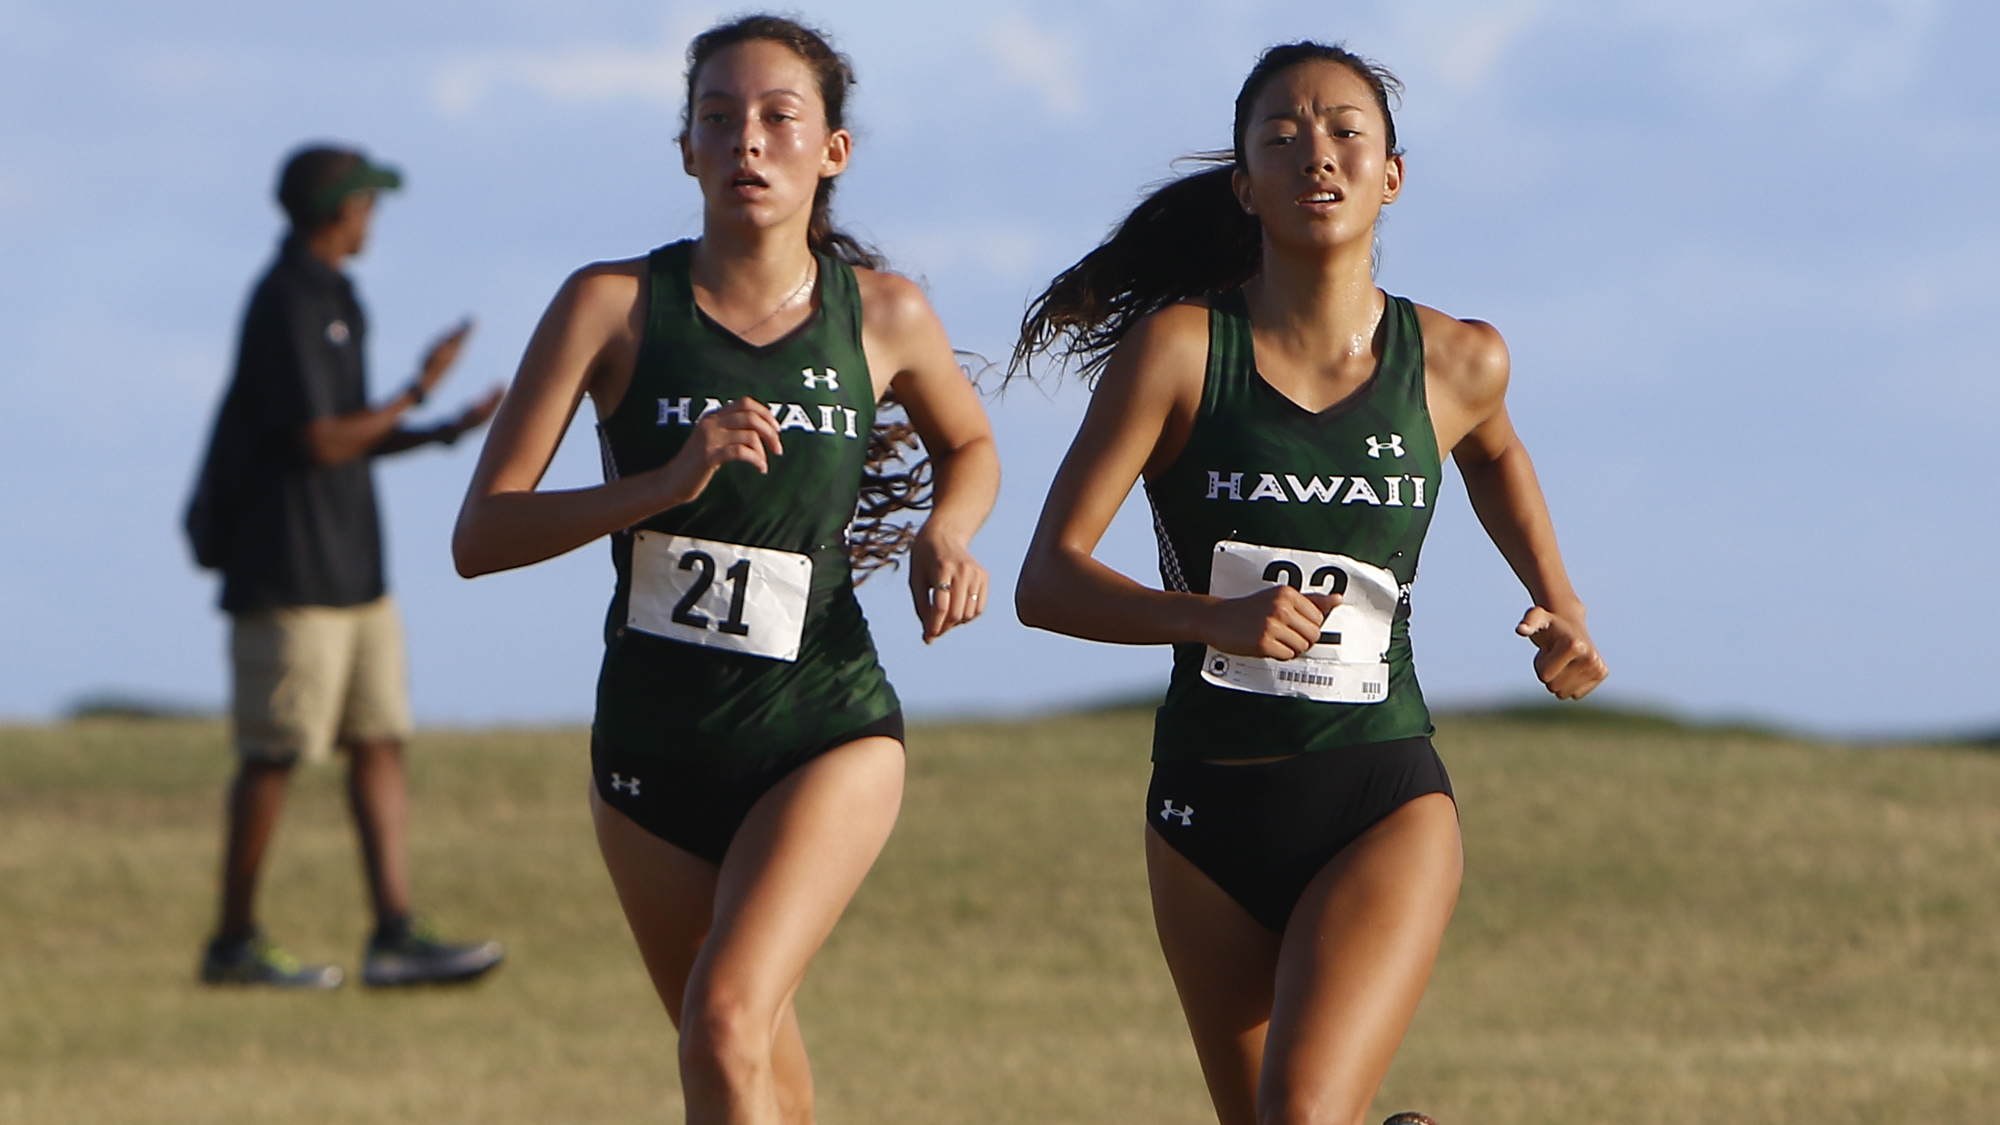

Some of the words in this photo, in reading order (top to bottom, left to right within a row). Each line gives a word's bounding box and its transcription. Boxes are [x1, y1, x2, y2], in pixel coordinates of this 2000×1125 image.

[656, 397, 858, 439] HAAI'I
[1205, 470, 1426, 508] HAWAI'I
[671, 549, 751, 637] 21
